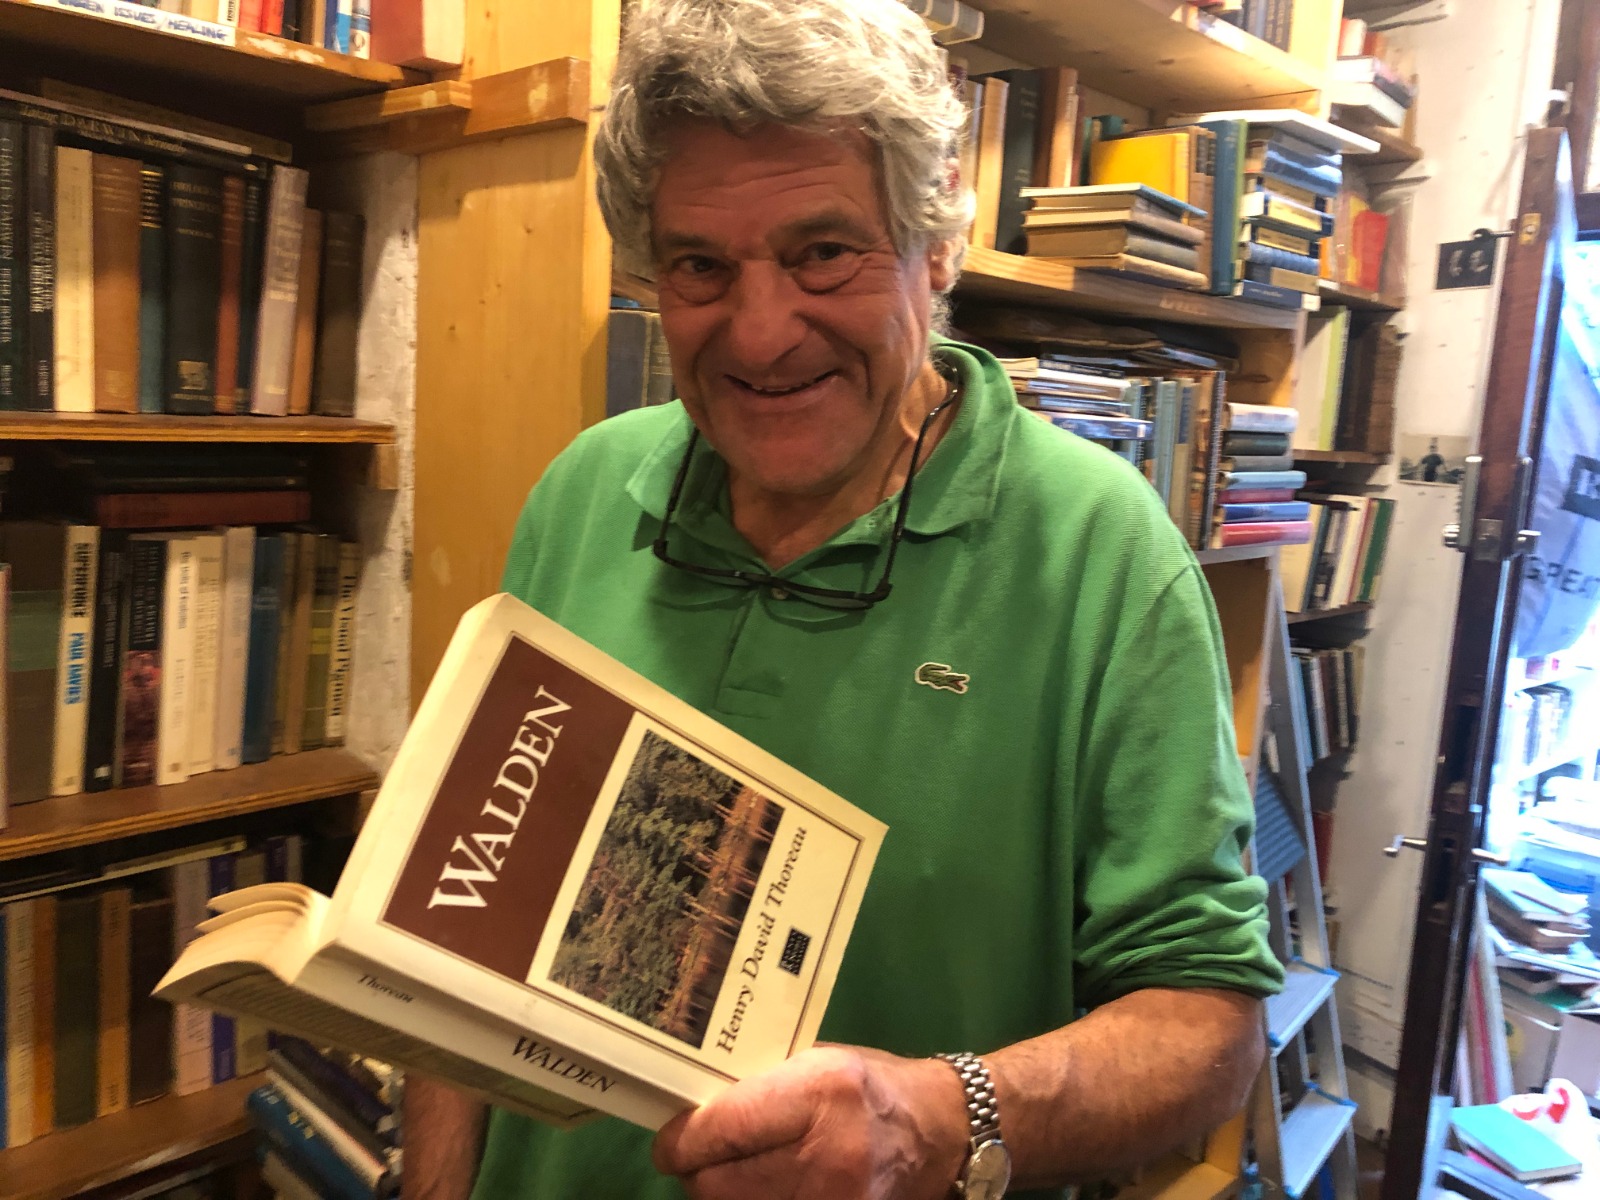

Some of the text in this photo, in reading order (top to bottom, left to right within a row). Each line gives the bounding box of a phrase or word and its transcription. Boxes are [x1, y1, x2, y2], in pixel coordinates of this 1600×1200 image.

[427, 685, 572, 909] WALDEN
[357, 973, 415, 1004] Thoreau
[716, 983, 755, 1054] Henry
[741, 911, 776, 981] David
[764, 826, 808, 909] Thoreau
[511, 1035, 616, 1093] WALDEN
